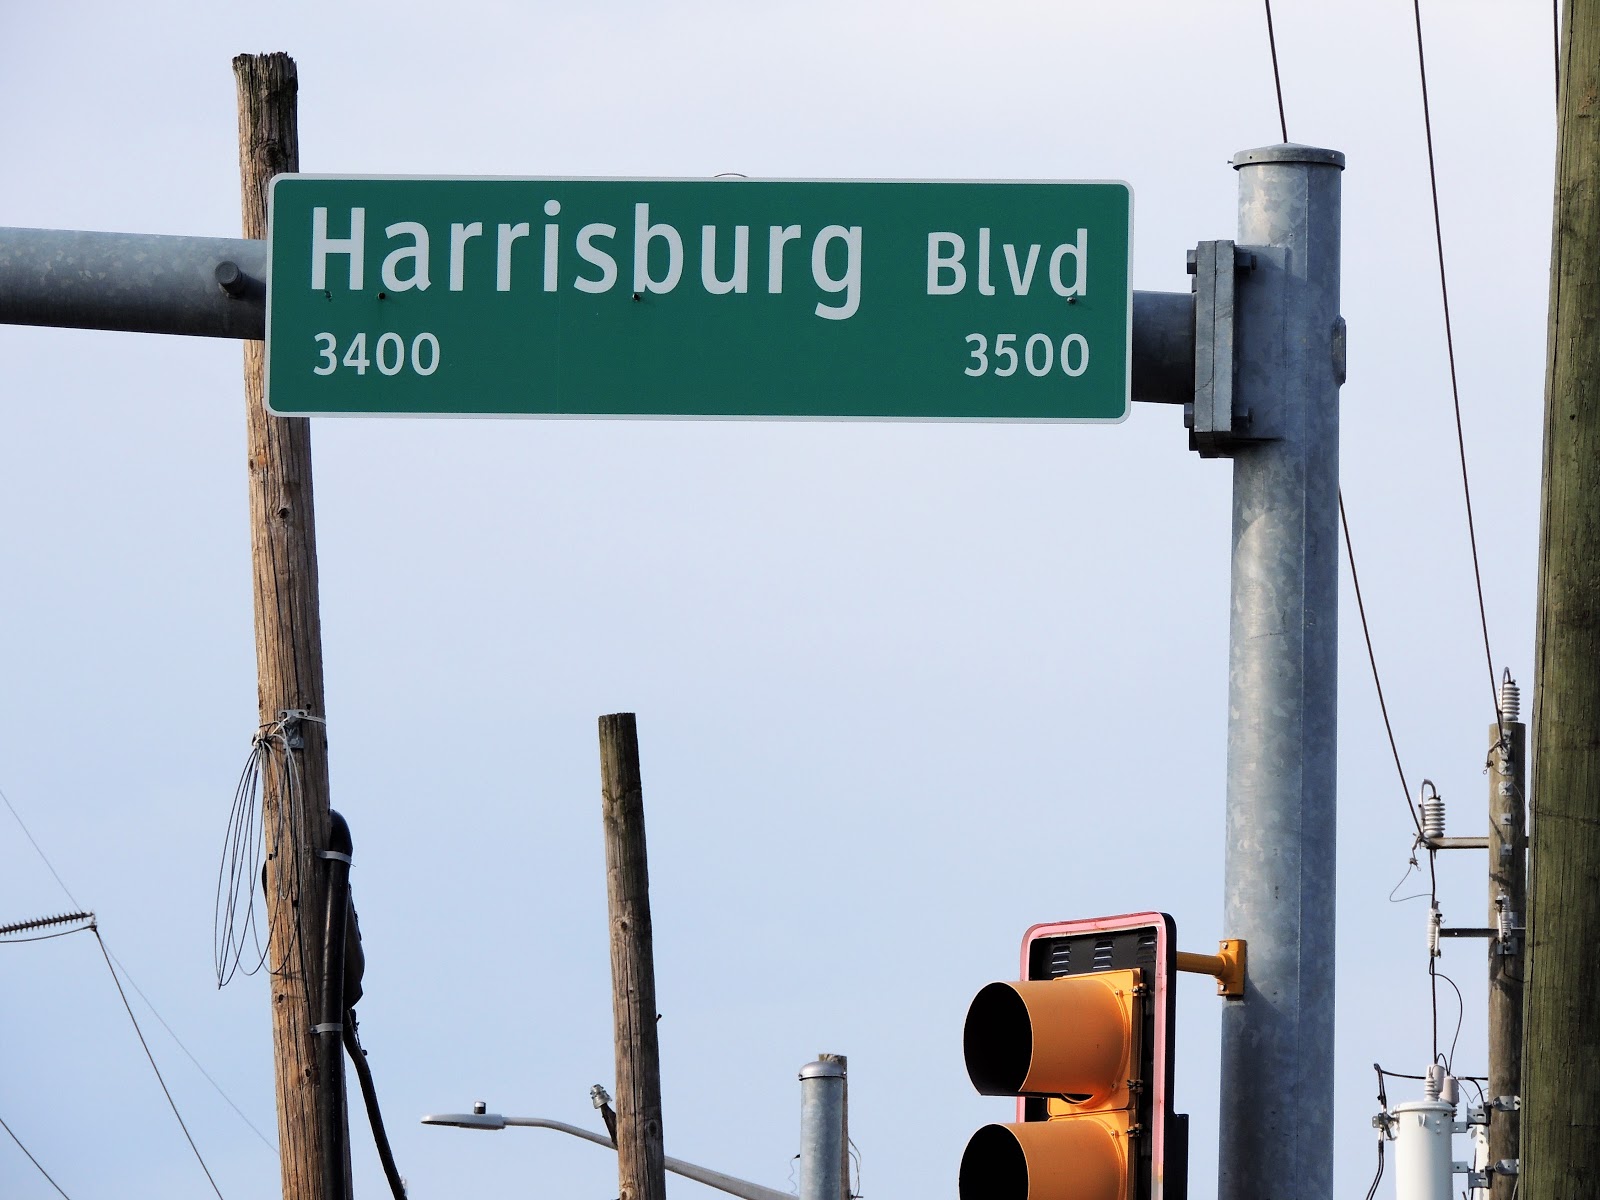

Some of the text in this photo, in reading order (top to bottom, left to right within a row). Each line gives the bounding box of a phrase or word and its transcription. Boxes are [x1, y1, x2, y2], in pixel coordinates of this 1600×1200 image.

[311, 200, 1088, 320] Harrisburg Blvd
[313, 332, 440, 376] 3400
[964, 333, 1089, 377] 3500
